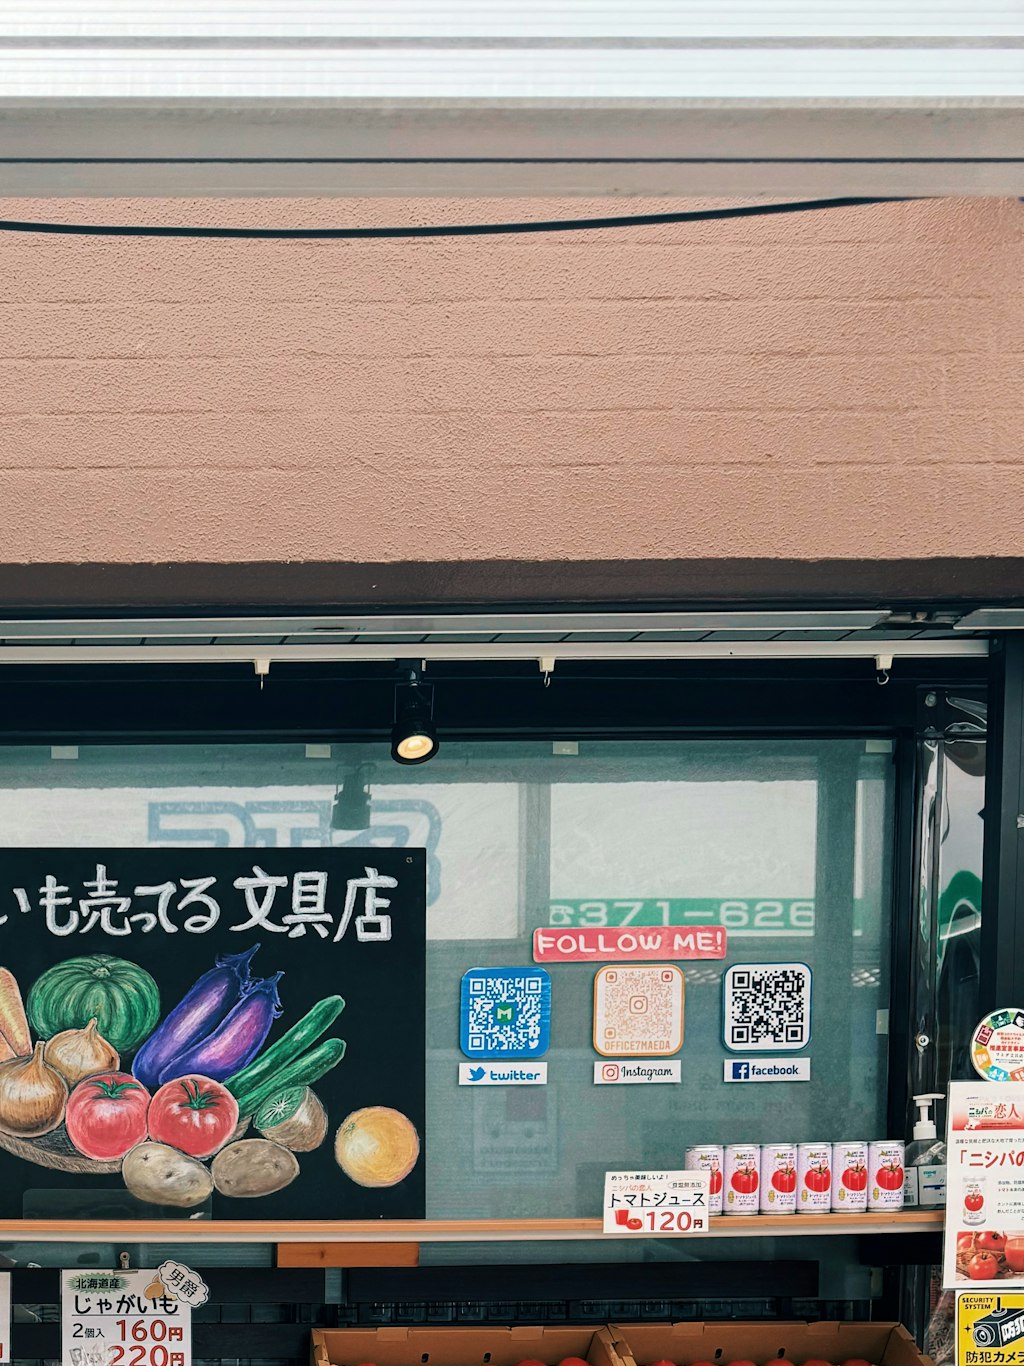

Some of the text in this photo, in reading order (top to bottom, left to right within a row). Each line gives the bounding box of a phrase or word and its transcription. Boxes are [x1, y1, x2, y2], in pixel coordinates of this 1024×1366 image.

[537, 932, 723, 954] FOLLOW ME!
[604, 1040, 671, 1050] OFFICE7MAEDA
[489, 1069, 541, 1082] twitter
[620, 1065, 673, 1079] Instagram
[751, 1064, 799, 1076] facebook
[611, 1192, 705, 1207] トマトジュース
[646, 1211, 703, 1231] 120円
[76, 1278, 121, 1290] 北海道産
[166, 1268, 200, 1298] 男爵
[74, 1294, 178, 1315] じゃがいも
[72, 1319, 183, 1342] 2個入 160円
